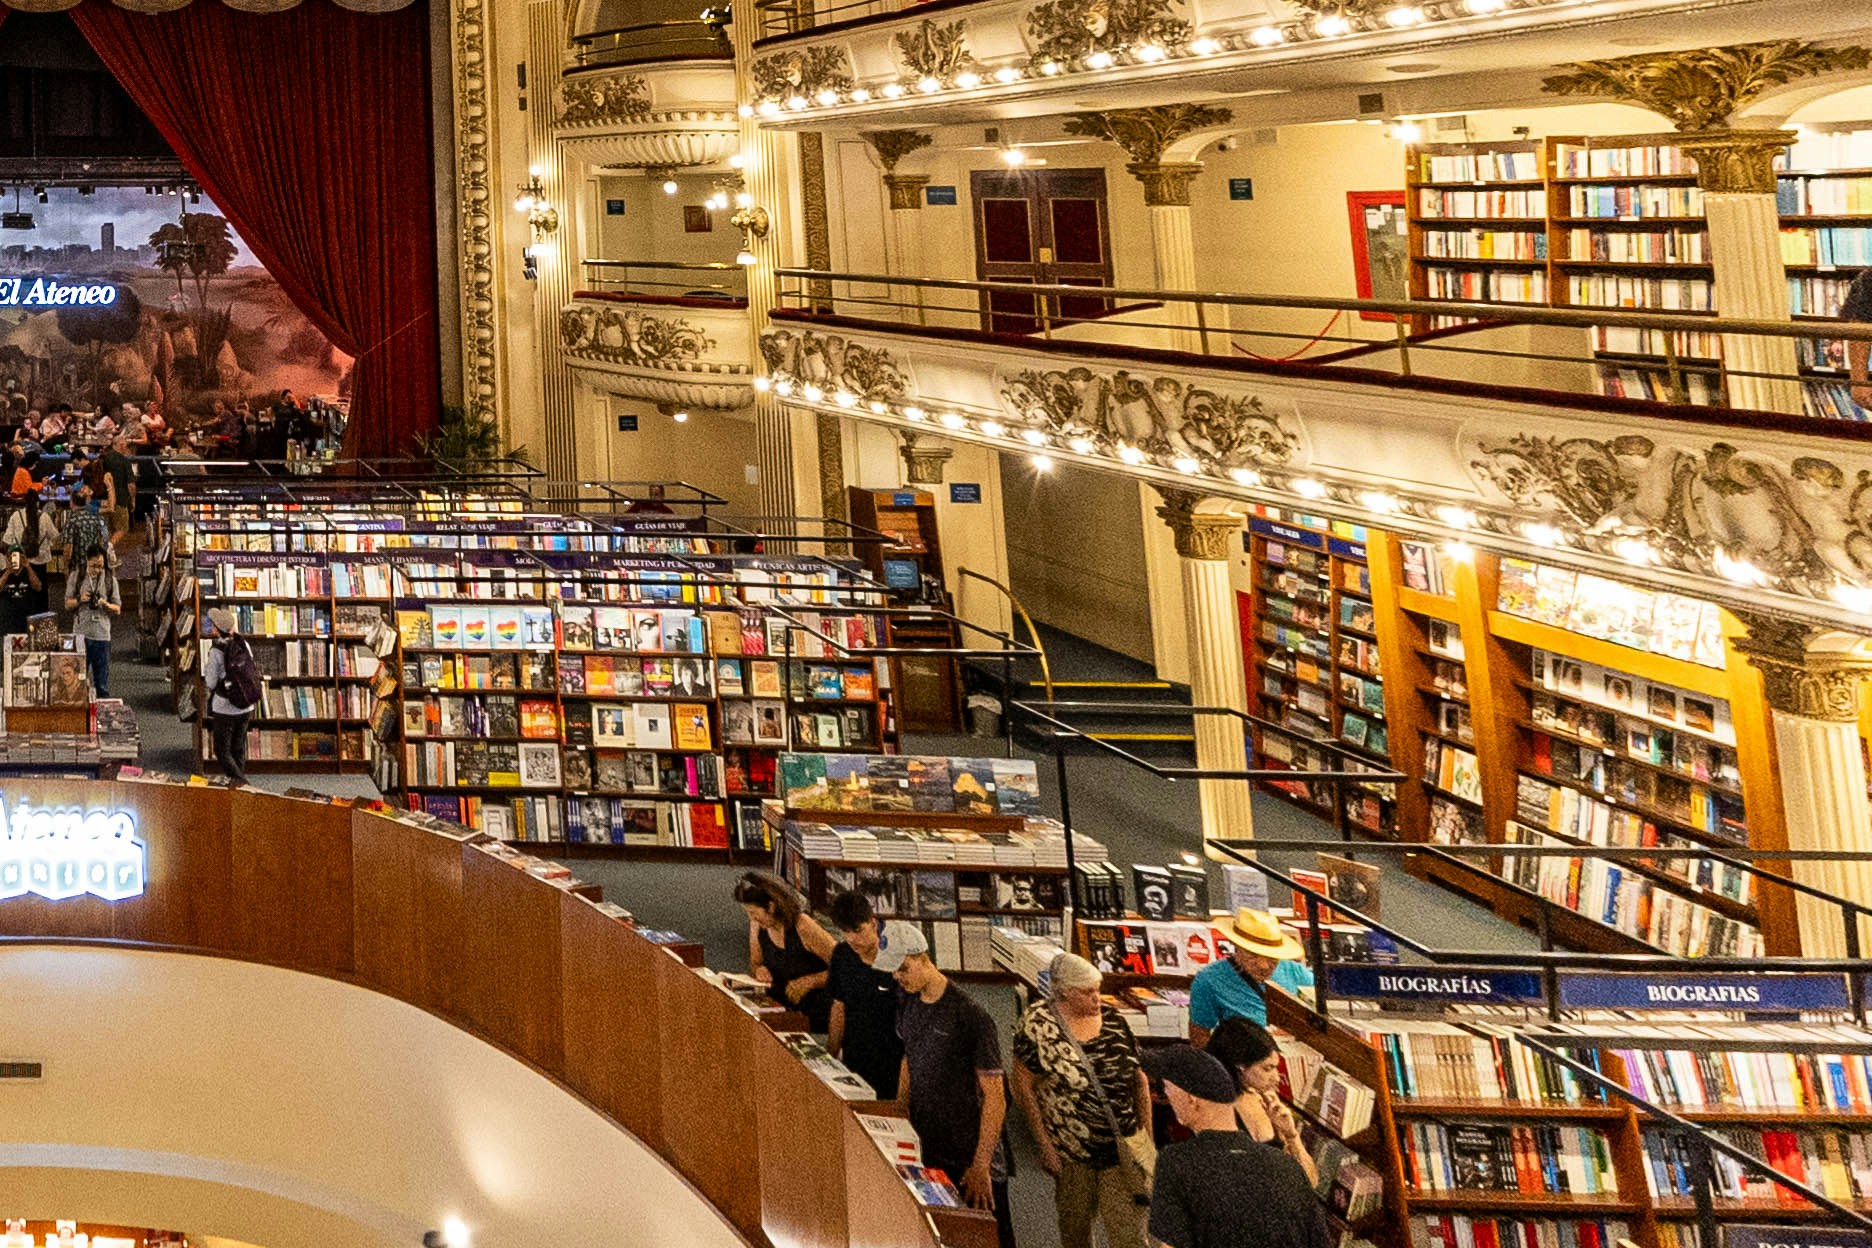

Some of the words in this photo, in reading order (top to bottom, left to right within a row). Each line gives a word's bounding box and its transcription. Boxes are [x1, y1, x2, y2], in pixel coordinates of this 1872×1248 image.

[22, 277, 117, 306] Ateneo
[613, 558, 660, 568] MARKETING
[660, 560, 667, 568] Y
[1378, 974, 1492, 995] BIOGRAFÍAS
[1646, 984, 1760, 1003] BIOGRAFIAS
